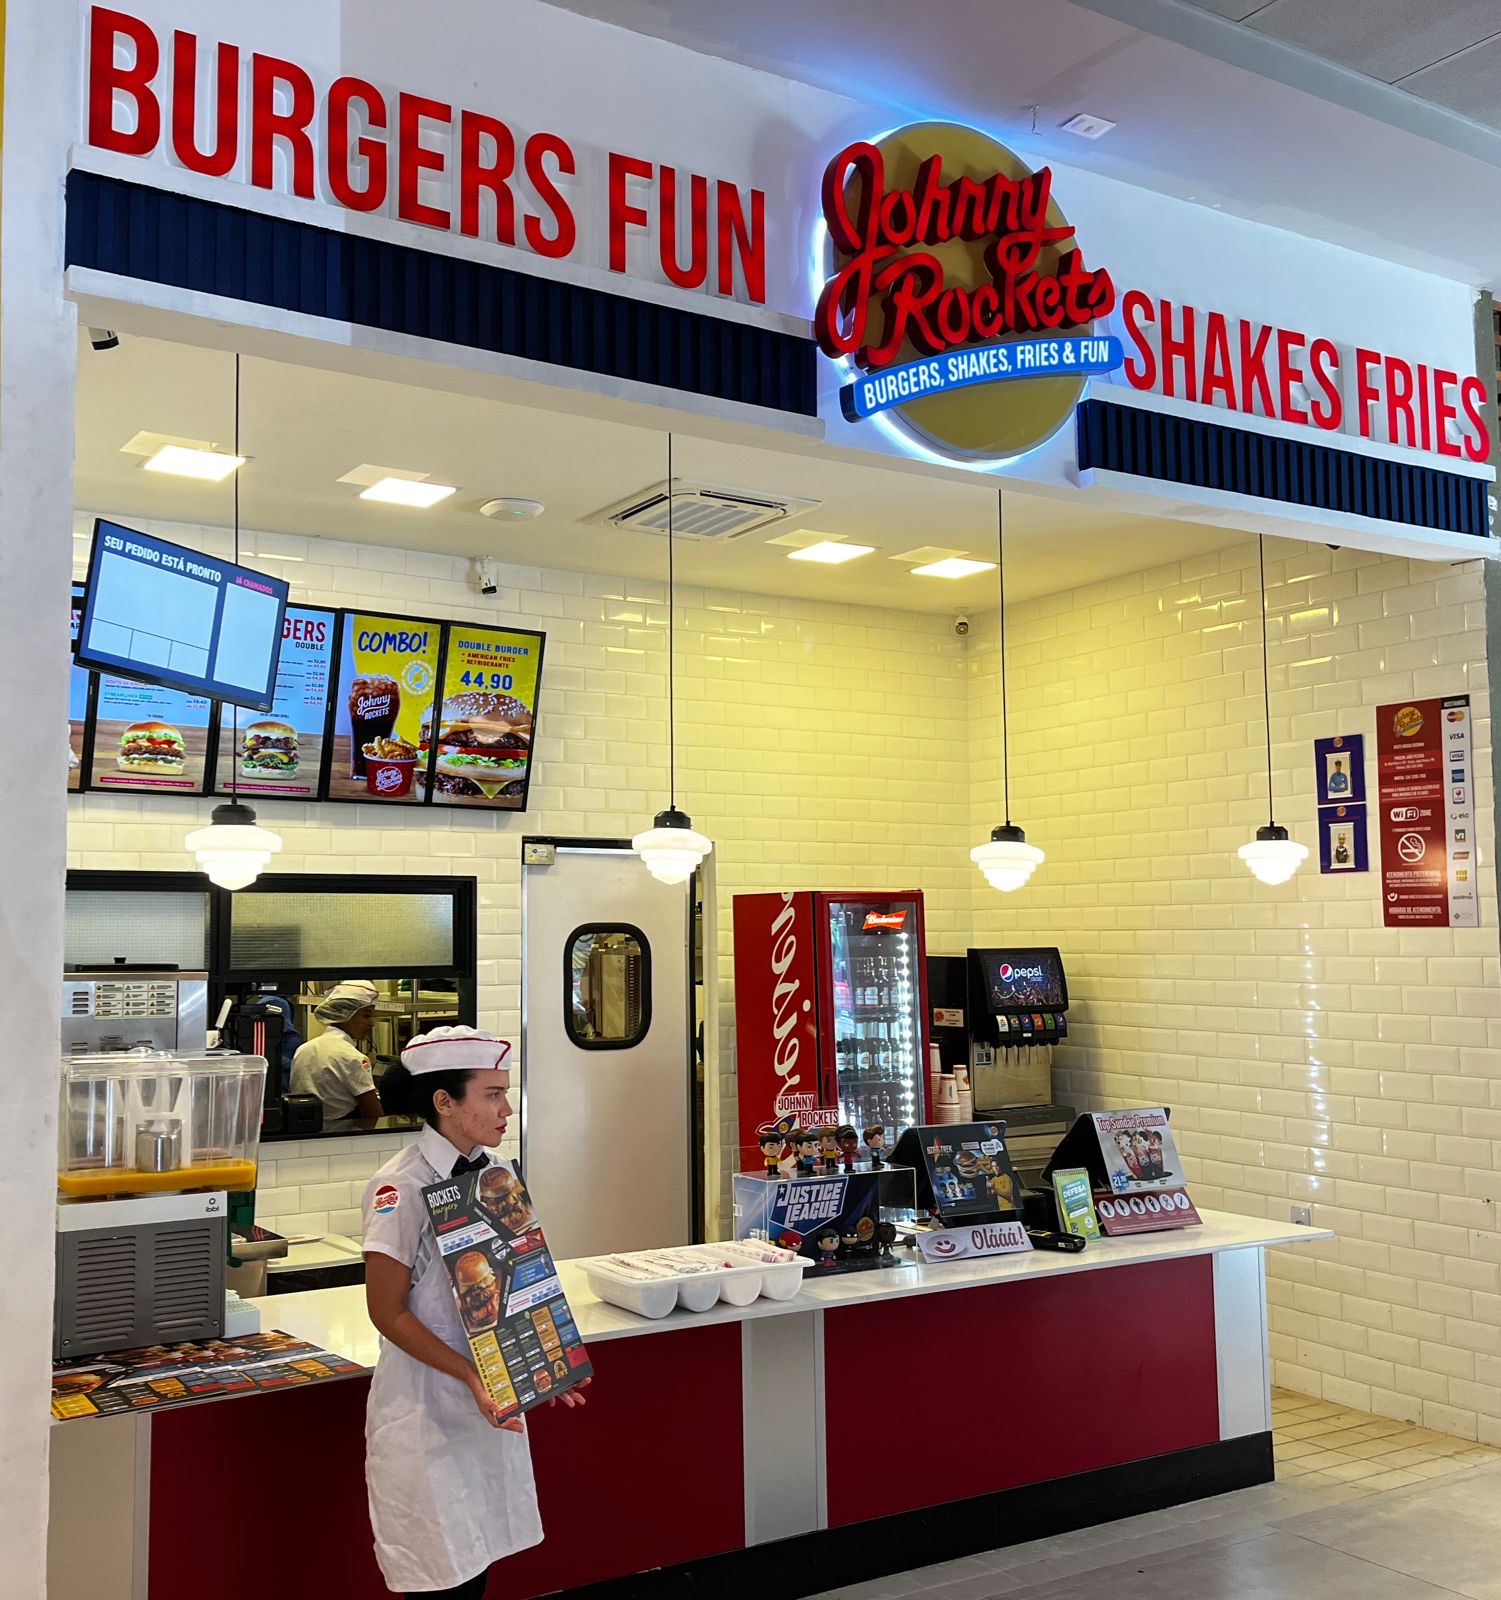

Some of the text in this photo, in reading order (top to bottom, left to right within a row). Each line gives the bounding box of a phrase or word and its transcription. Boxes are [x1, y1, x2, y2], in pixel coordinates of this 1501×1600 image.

[88, 5, 766, 304] BURGERS FUN
[815, 142, 1075, 358] Johnny
[856, 247, 1116, 366] Rockets
[863, 340, 1109, 409] BURGERS, SHAKES, FRIES & FUN
[1121, 289, 1491, 463] SHAKES FRIES
[104, 535, 222, 583] SEU PEDIDO ESTÁ PRONTO
[282, 617, 327, 643] GERS
[295, 641, 325, 651] DOUBLE
[358, 630, 429, 655] COMBO!
[458, 640, 530, 656] DOUBLE BURGER
[466, 653, 498, 661] AMERICAN
[499, 655, 516, 663] FRIES
[466, 658, 510, 669] REFRIGERANTE
[460, 670, 513, 691] 44,90
[357, 694, 391, 716] Johnny
[364, 706, 390, 721] ROCKETS
[1449, 732, 1465, 740] VISA
[1013, 965, 1043, 979] pepsi
[778, 1094, 814, 1111] JOHNNY
[801, 1110, 839, 1126] ROCKETS
[1096, 1113, 1166, 1133] Top Sundae Premium
[427, 1185, 461, 1209] ROCKETS
[777, 1182, 844, 1207] JUSTICE
[1063, 1184, 1087, 1199] DEFESA
[784, 1200, 839, 1229] LEAGUE
[971, 1225, 1025, 1250] Olááá!
